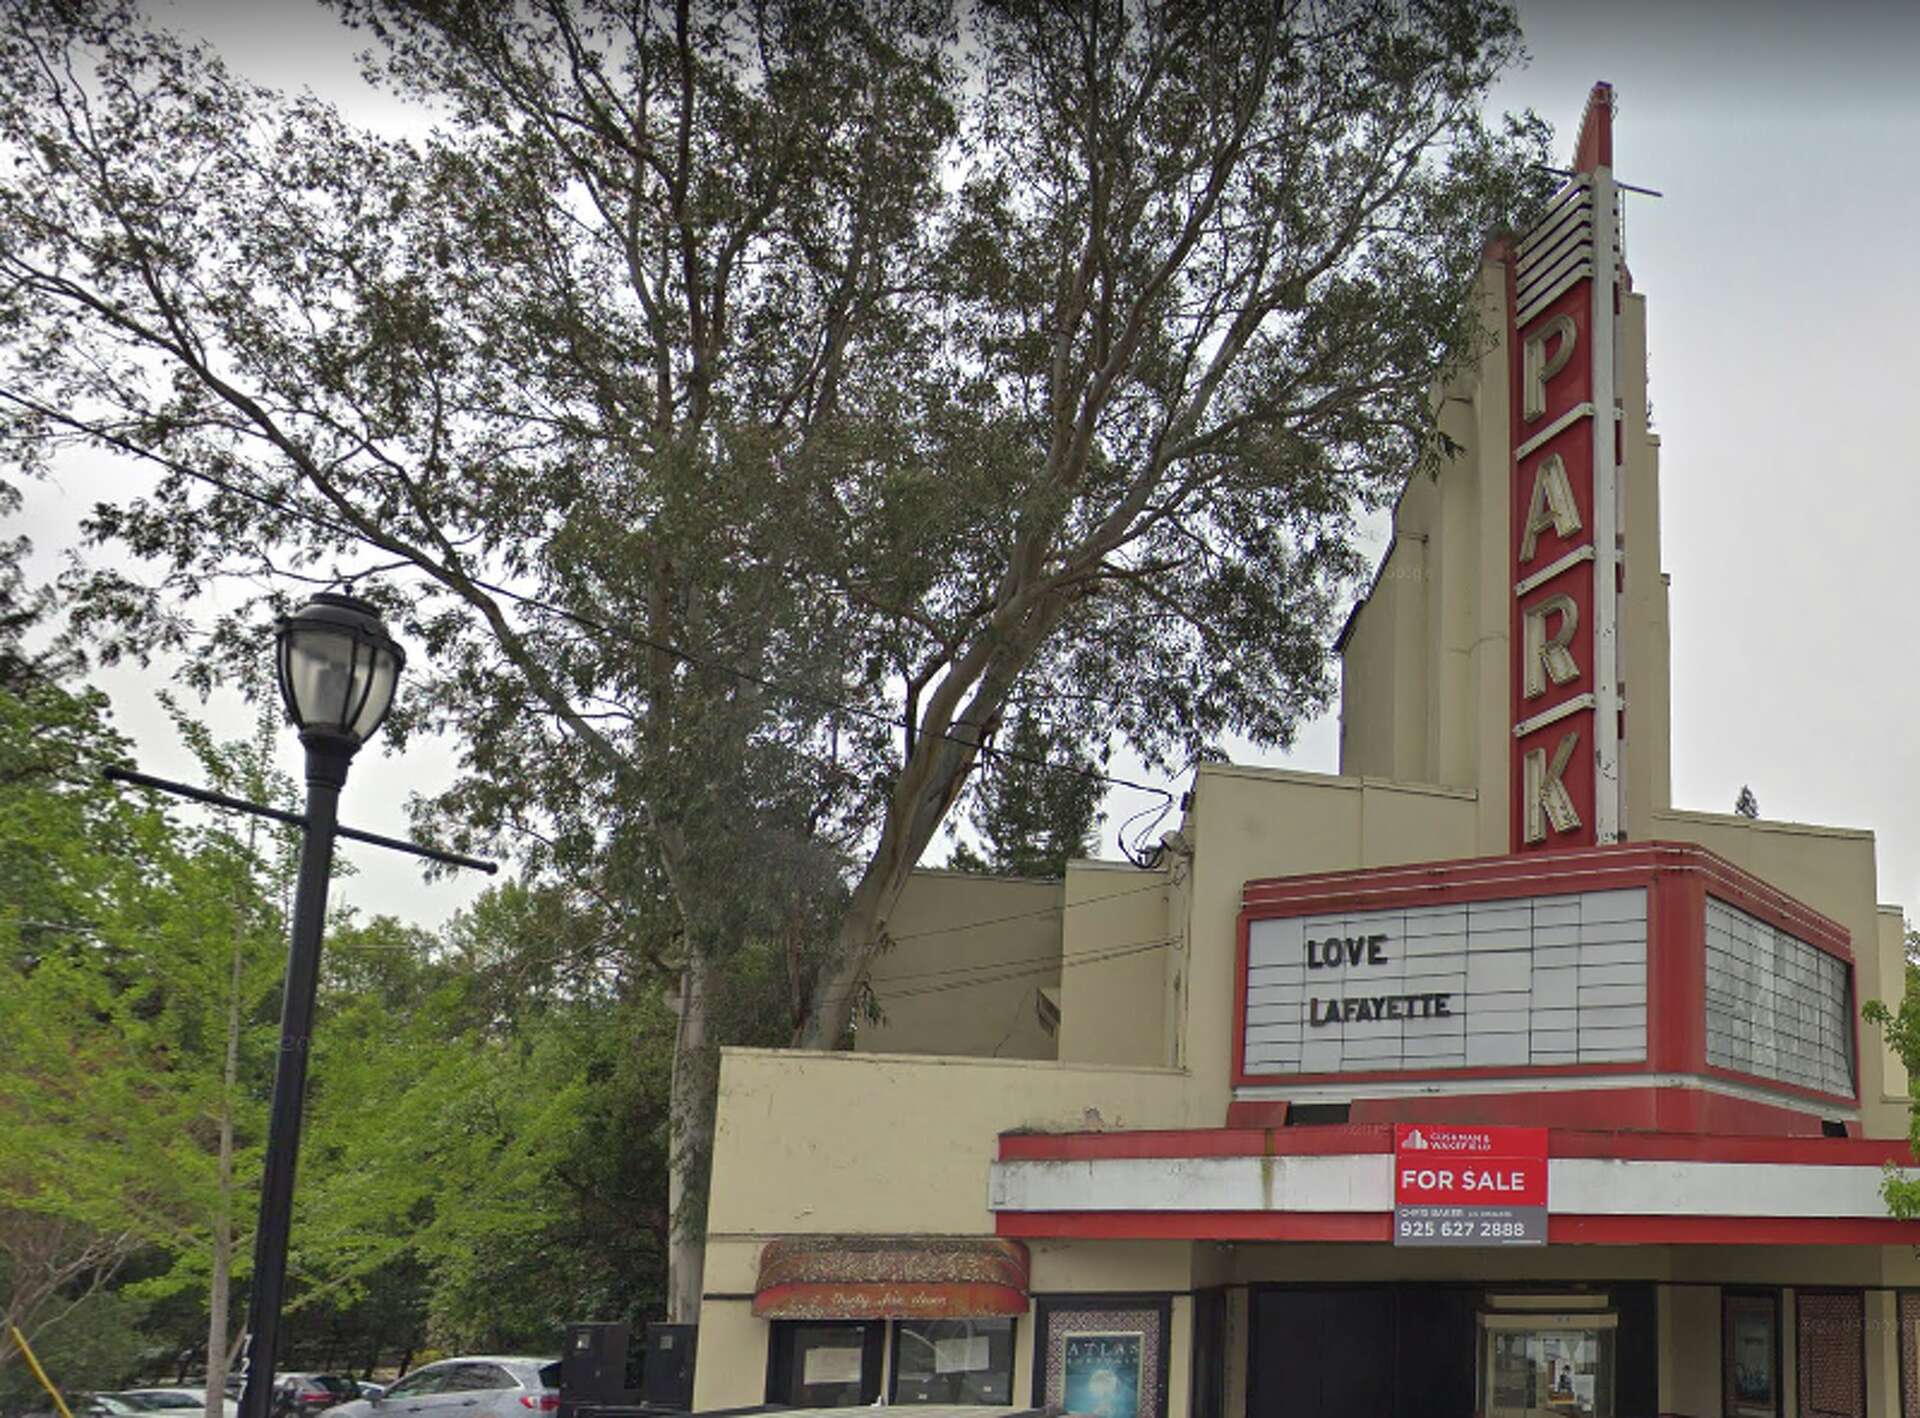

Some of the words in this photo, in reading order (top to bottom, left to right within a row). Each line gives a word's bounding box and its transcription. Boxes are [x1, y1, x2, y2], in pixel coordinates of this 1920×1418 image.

[1521, 313, 1582, 844] PARK
[1308, 934, 1387, 969] LOVE
[1310, 993, 1450, 1027] LAFAYETTE
[1402, 1170, 1454, 1189] FOR
[1461, 1171, 1525, 1191] SALE
[1400, 1221, 1434, 1237] 925
[1441, 1222, 1474, 1237] 627
[1480, 1222, 1525, 1237] 2888
